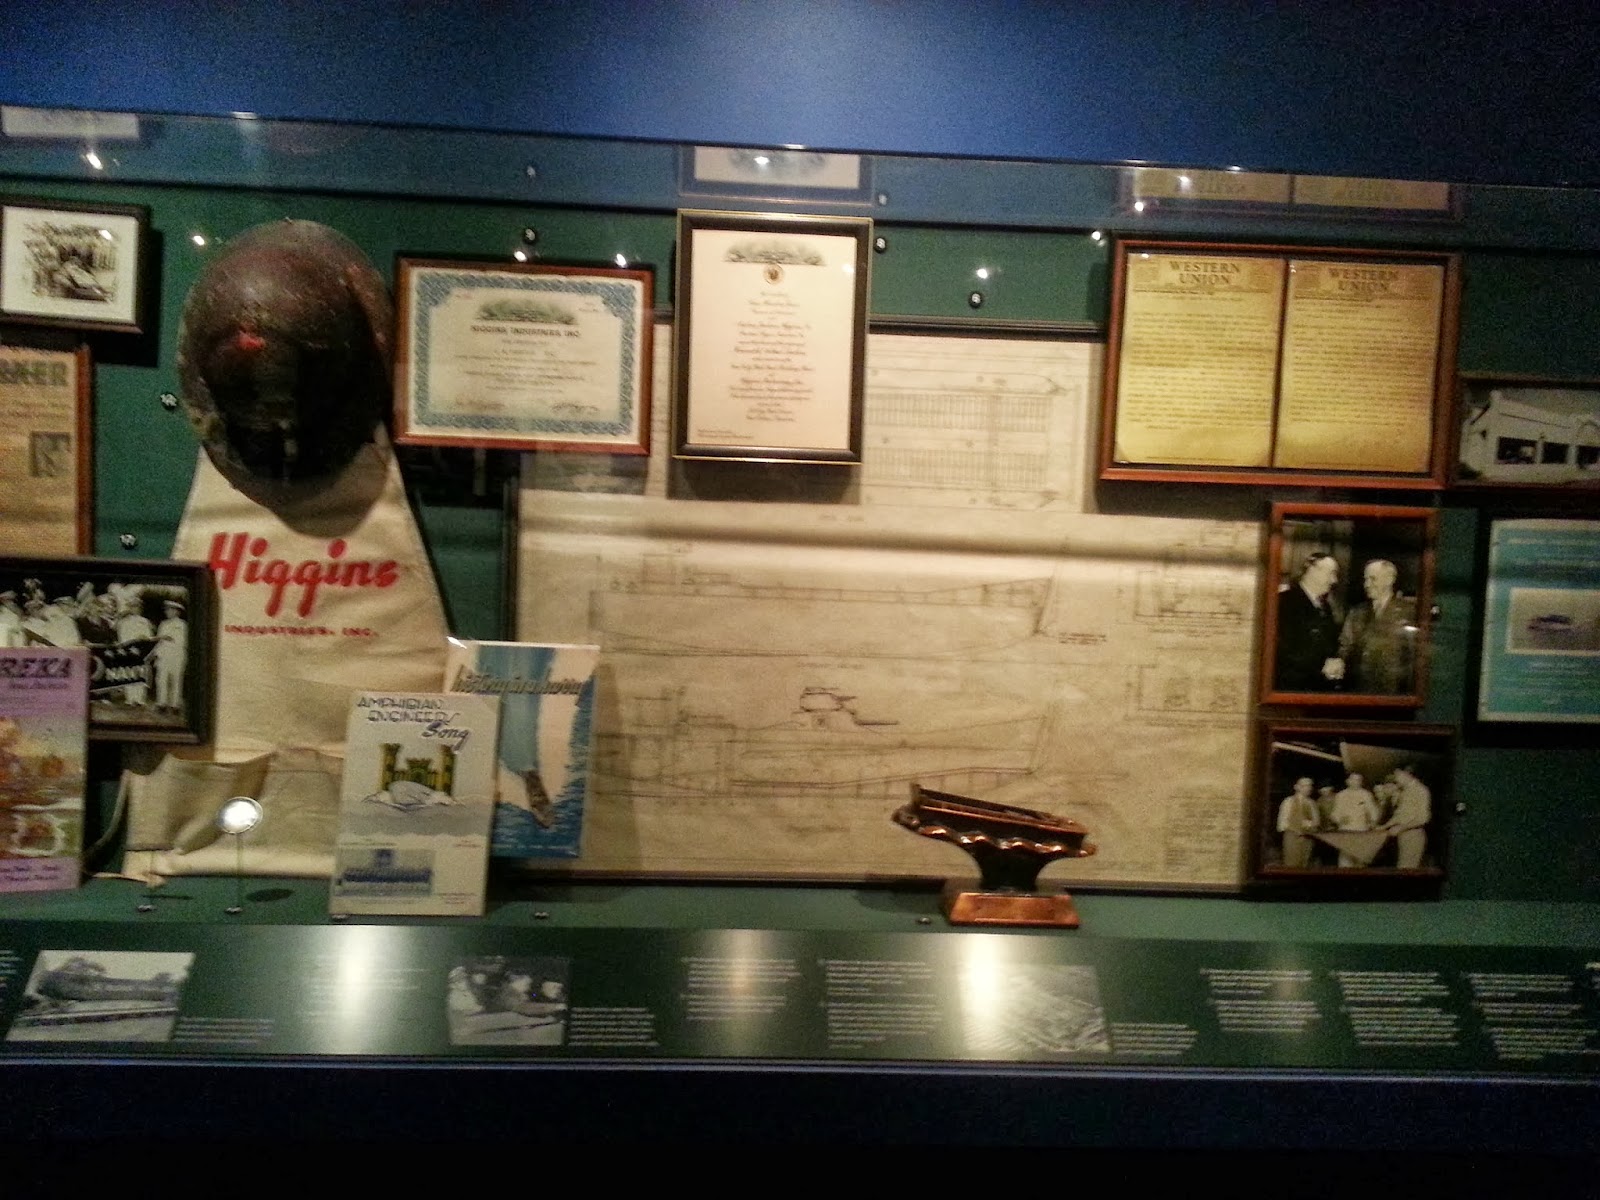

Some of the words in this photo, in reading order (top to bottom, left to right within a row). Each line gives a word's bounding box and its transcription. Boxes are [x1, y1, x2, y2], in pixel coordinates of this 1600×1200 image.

[1169, 260, 1242, 274] WESTERN
[1178, 273, 1231, 286] UNION
[1328, 268, 1400, 282] WESTERN
[1336, 280, 1390, 292] UNION
[208, 531, 400, 618] Higgins
[356, 697, 443, 711] AMPHIBIAN
[421, 721, 471, 752] Song
